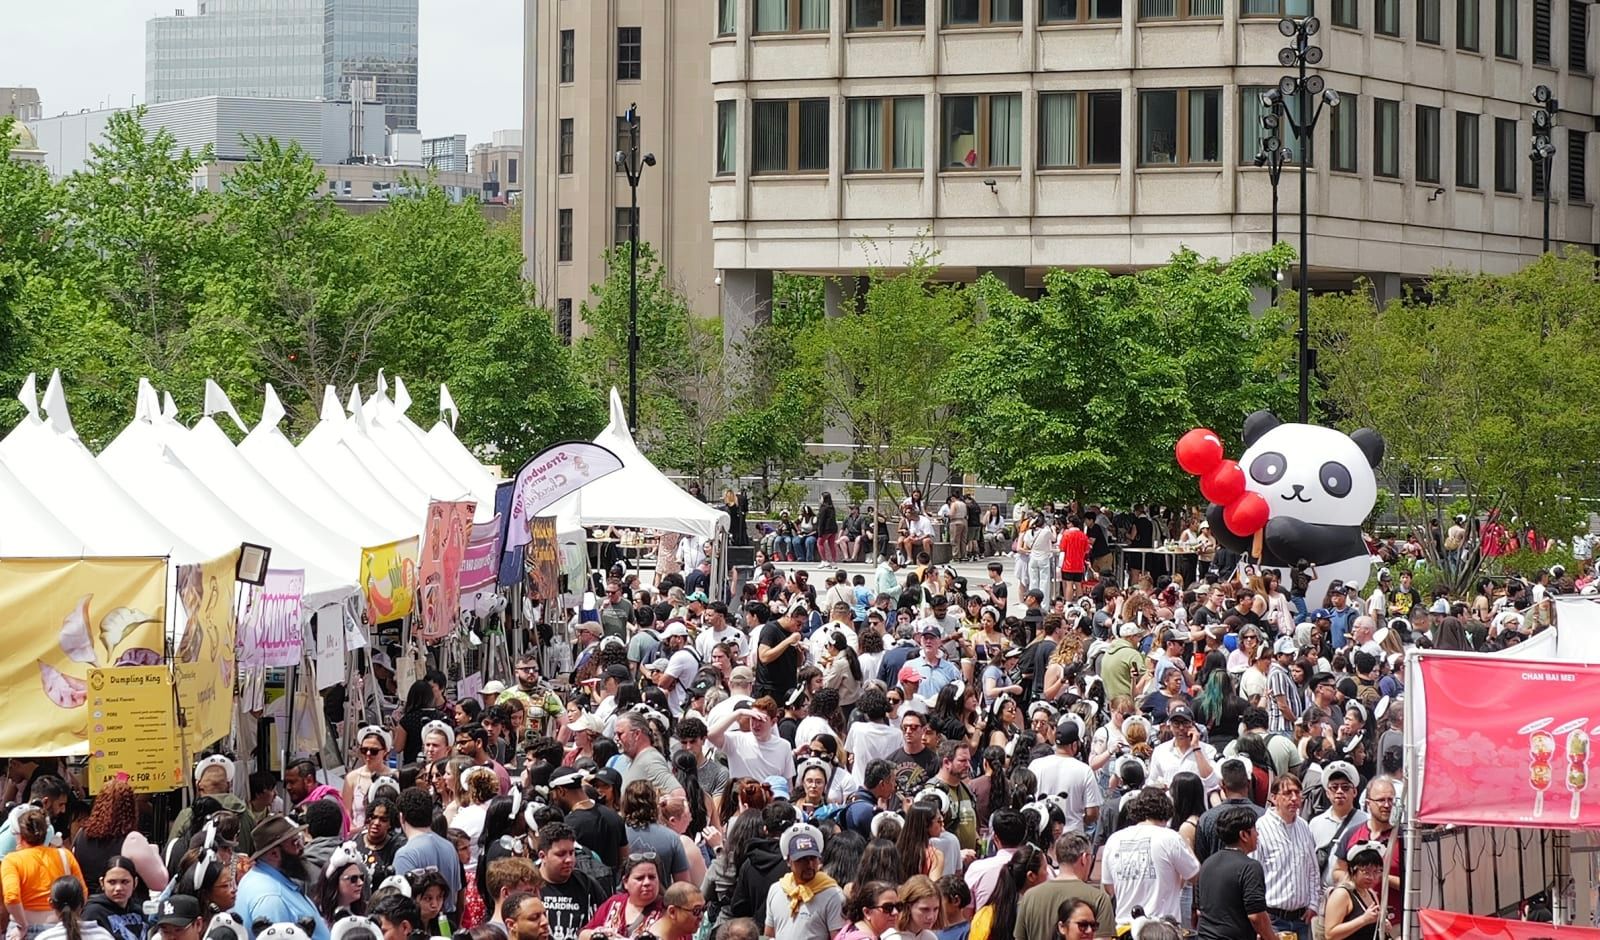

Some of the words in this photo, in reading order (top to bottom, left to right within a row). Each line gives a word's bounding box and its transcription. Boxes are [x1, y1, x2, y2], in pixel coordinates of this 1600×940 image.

[110, 674, 144, 685] Dumpling
[145, 673, 161, 684] King
[1521, 672, 1544, 680] CHAN
[1560, 673, 1575, 682] MEI
[137, 773, 150, 782] FOR
[543, 902, 580, 910] OARDING
